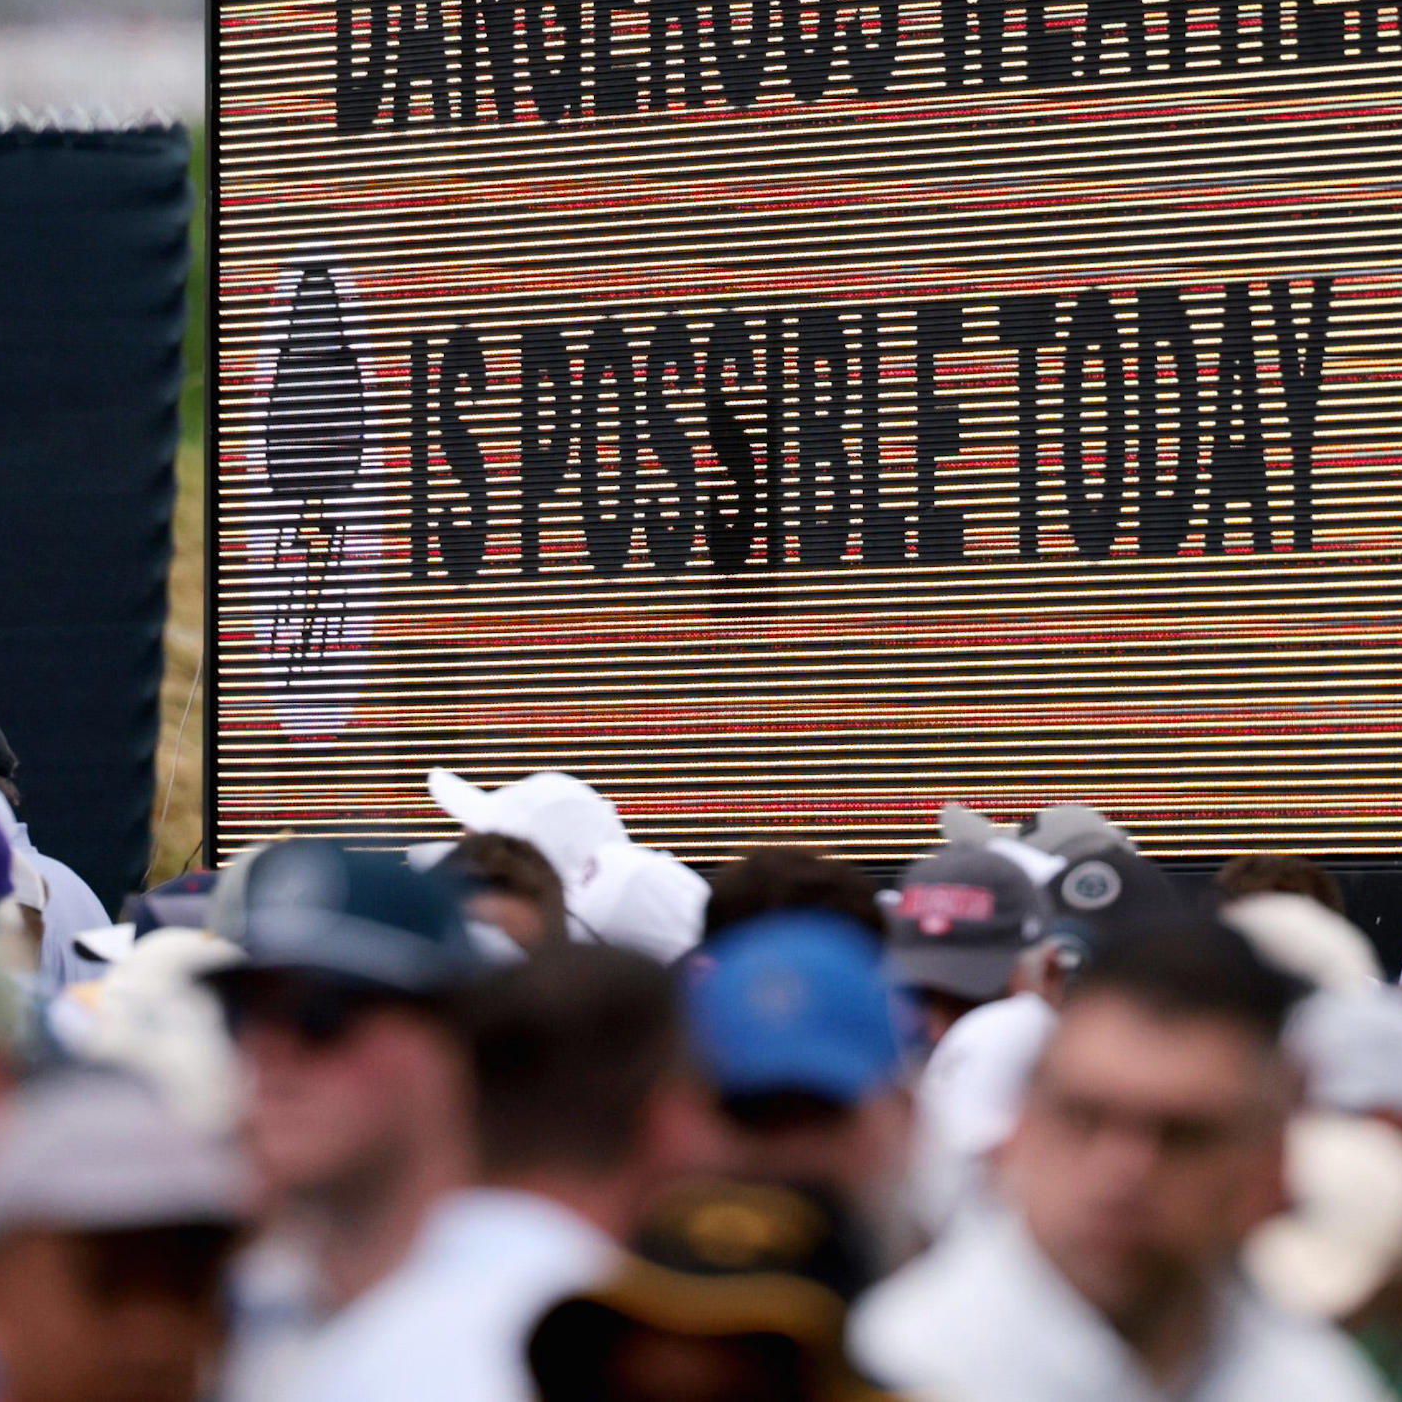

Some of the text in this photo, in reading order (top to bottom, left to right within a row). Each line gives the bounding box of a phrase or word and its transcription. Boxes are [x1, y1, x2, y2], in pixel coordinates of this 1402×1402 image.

[410, 276, 1334, 582] IS POSSIBLE TODAY
